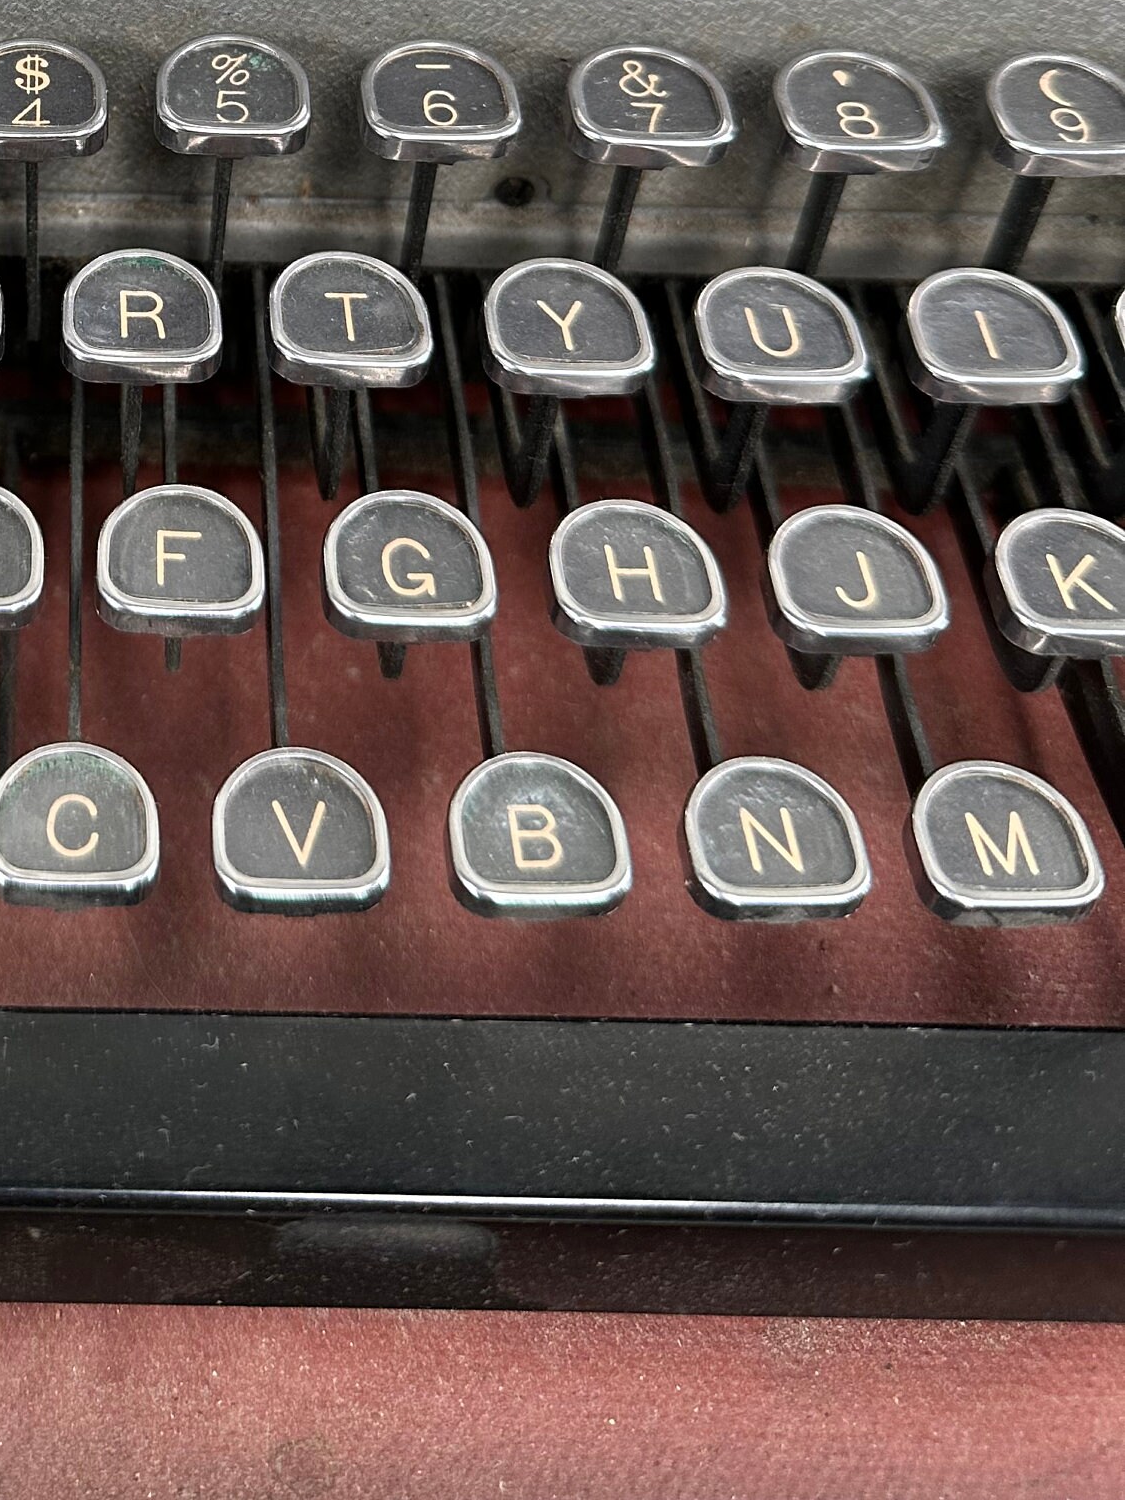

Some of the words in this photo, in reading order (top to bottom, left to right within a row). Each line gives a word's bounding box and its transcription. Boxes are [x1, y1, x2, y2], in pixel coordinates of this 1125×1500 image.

[14, 54, 51, 95] $
[211, 52, 250, 86] %
[618, 60, 668, 98] &
[11, 97, 51, 128] 4
[215, 90, 250, 124] 5
[422, 90, 459, 126] 6
[630, 102, 665, 133] 7
[836, 101, 879, 140] 8
[1049, 107, 1090, 143] 9
[118, 289, 167, 340] R
[323, 291, 368, 342] T
[536, 299, 582, 351] Y
[743, 307, 800, 358] U
[975, 310, 1002, 360] I
[155, 528, 203, 586] F
[380, 536, 437, 597] G
[603, 543, 664, 603] H
[835, 550, 877, 609] J
[1045, 553, 1117, 612] K
[45, 793, 101, 859] C
[271, 798, 326, 867] V
[506, 803, 563, 871] B
[739, 806, 806, 875] N
[964, 811, 1041, 878] M
